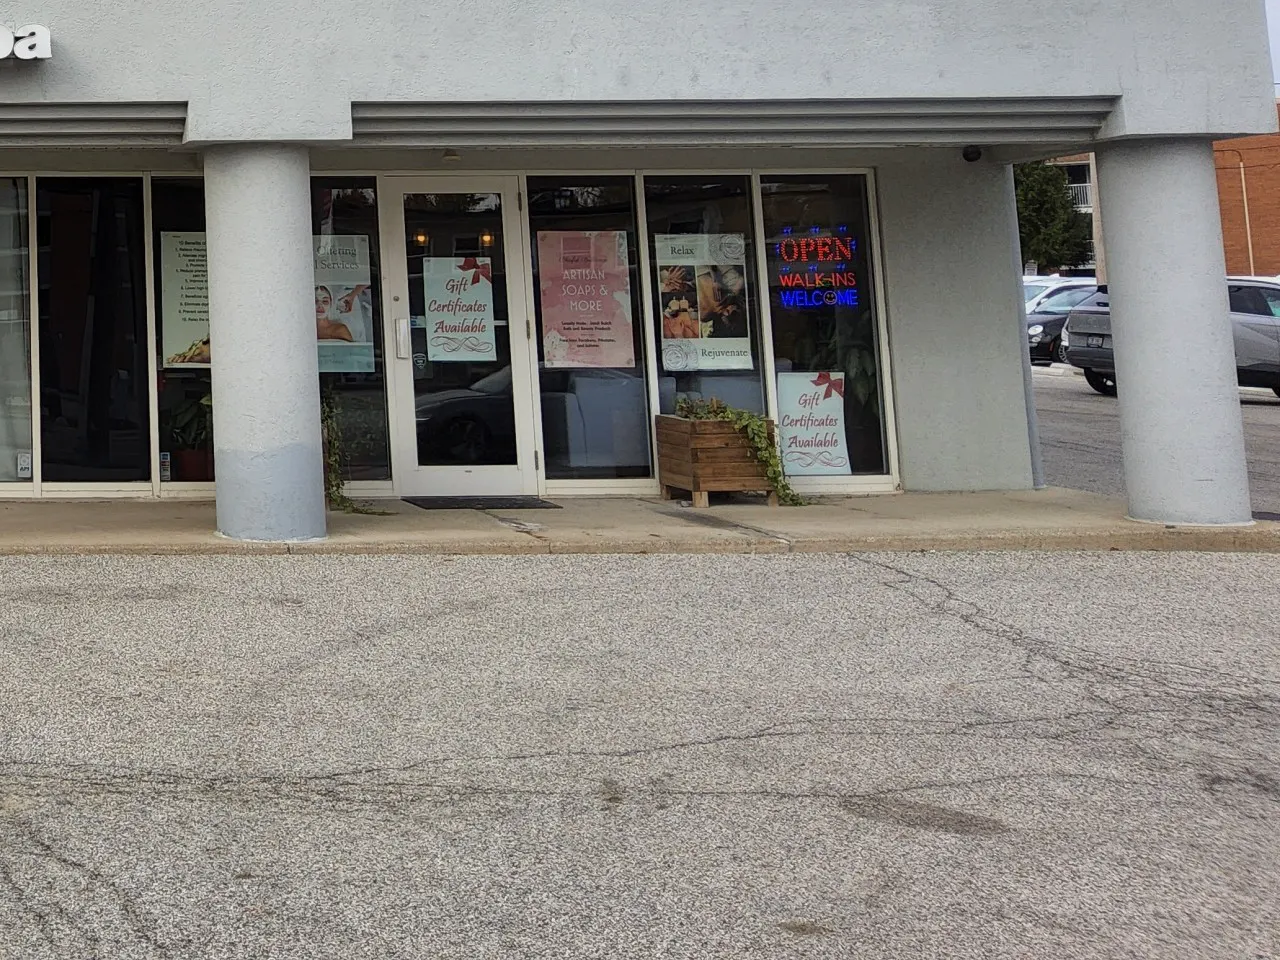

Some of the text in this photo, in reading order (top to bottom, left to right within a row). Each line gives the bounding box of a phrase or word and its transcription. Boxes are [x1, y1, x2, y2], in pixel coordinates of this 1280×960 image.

[670, 246, 696, 256] Relax
[780, 237, 853, 262] OPEN
[320, 259, 360, 270] Services
[563, 269, 606, 280] ARTISAN
[779, 272, 856, 288] WALK-INS
[445, 276, 469, 295] Gift
[562, 284, 609, 296] SOAPS &
[570, 300, 603, 311] MORE
[780, 289, 858, 306] WELCOME
[428, 298, 487, 315] Certificates
[433, 318, 487, 333] Available
[701, 348, 748, 360] Rejuvenate
[798, 392, 820, 409] Gift
[782, 412, 838, 430] Certificates
[788, 432, 839, 448] Available
